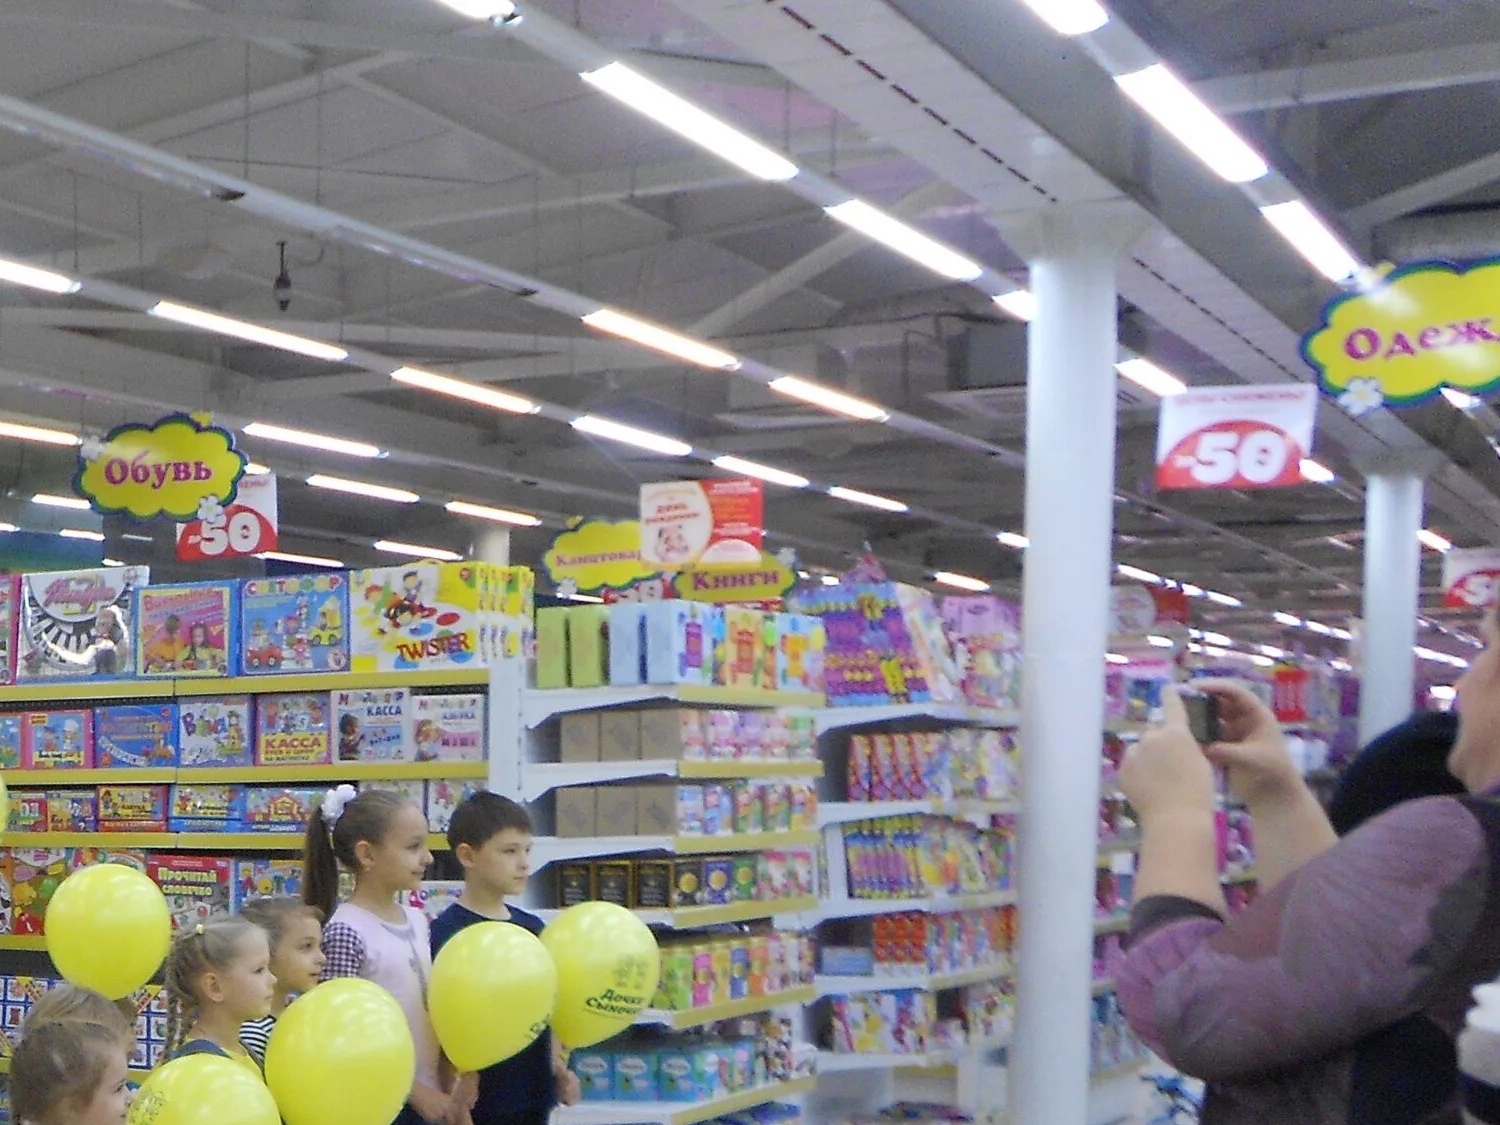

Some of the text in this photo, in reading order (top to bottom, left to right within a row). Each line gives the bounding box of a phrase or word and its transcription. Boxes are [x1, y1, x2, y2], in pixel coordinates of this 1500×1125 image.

[104, 451, 212, 489] Обувь
[693, 570, 780, 591] Книги
[396, 631, 471, 663] TWISTER
[365, 705, 403, 717] КАССА
[264, 737, 321, 750] КАССА
[157, 866, 218, 884] Прочитай
[161, 884, 214, 897] словечко
